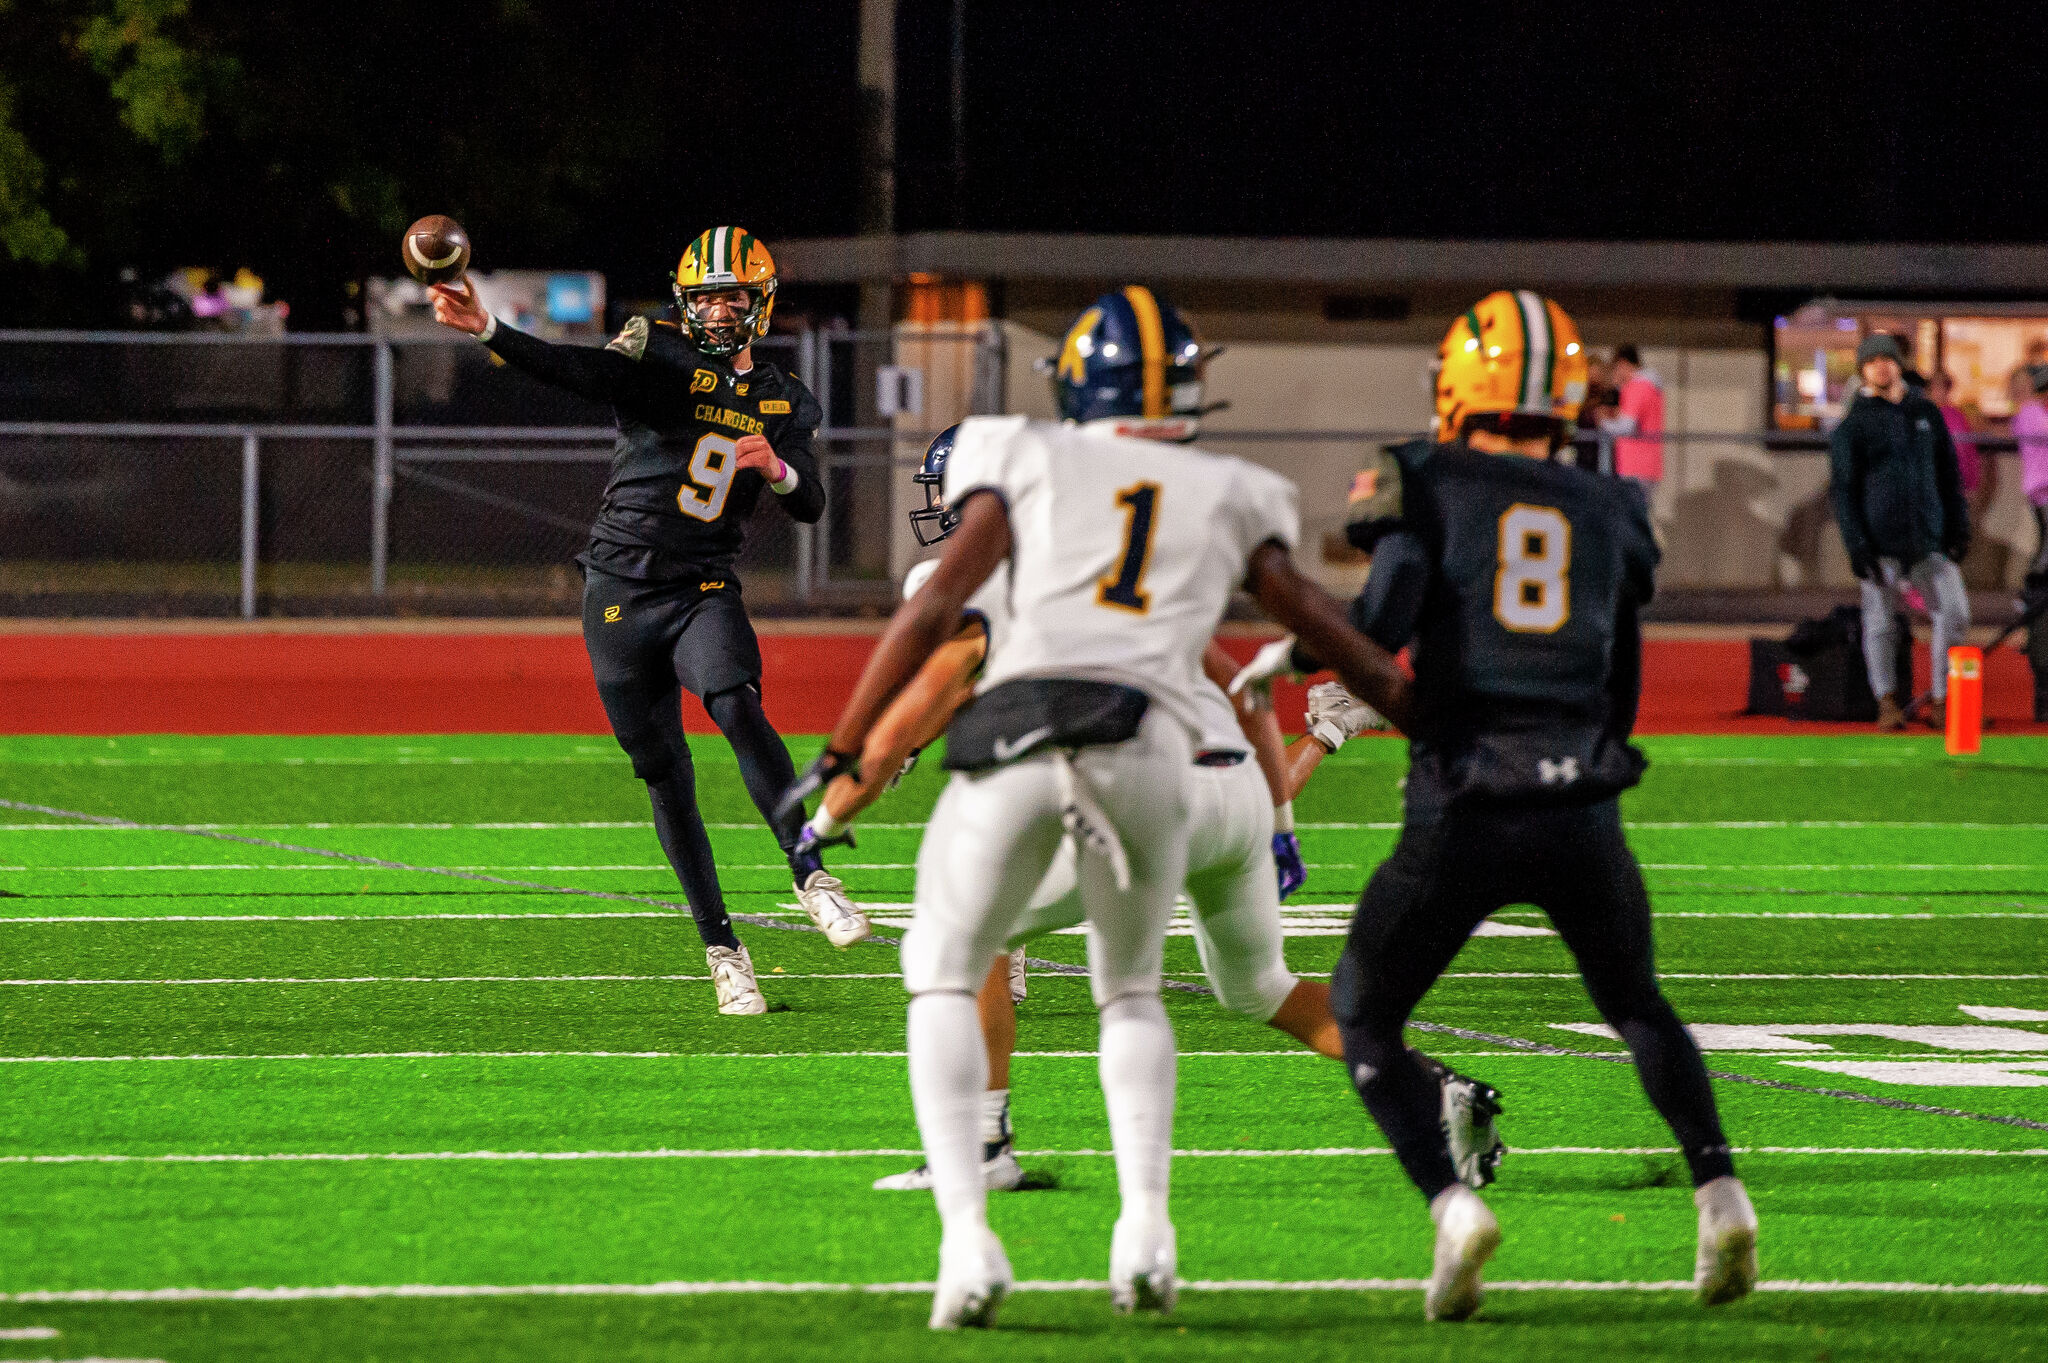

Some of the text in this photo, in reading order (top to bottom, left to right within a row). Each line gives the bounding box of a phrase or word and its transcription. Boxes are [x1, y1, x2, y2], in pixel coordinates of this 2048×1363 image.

[695, 404, 764, 435] CHARGERS
[677, 431, 738, 523] 9
[1095, 480, 1163, 617] 1
[1493, 502, 1572, 634] 8
